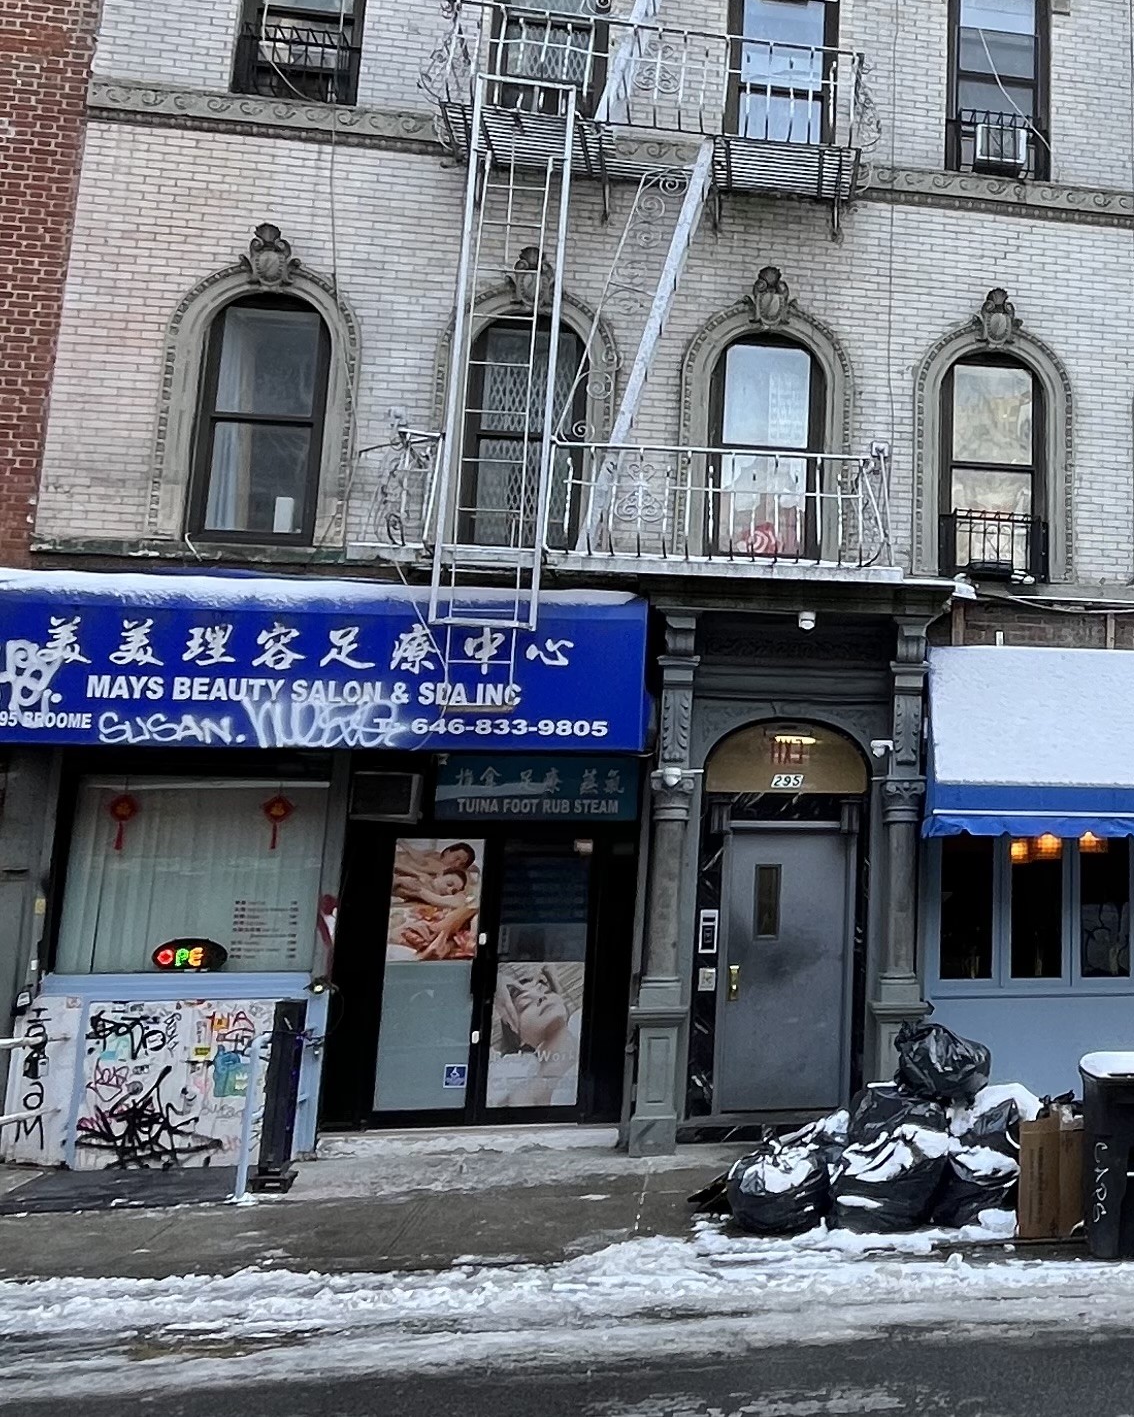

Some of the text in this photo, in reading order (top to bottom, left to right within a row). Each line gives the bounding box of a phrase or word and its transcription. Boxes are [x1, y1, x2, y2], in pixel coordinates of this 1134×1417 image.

[37, 615, 575, 675] 美美理容足療中心
[86, 674, 522, 706] MAYS BEAUTY SALON & SPA INC
[410, 717, 609, 738] 646-833-9805
[773, 775, 801, 787] 295
[457, 798, 619, 815] TUINA FOOT RUB STEAM
